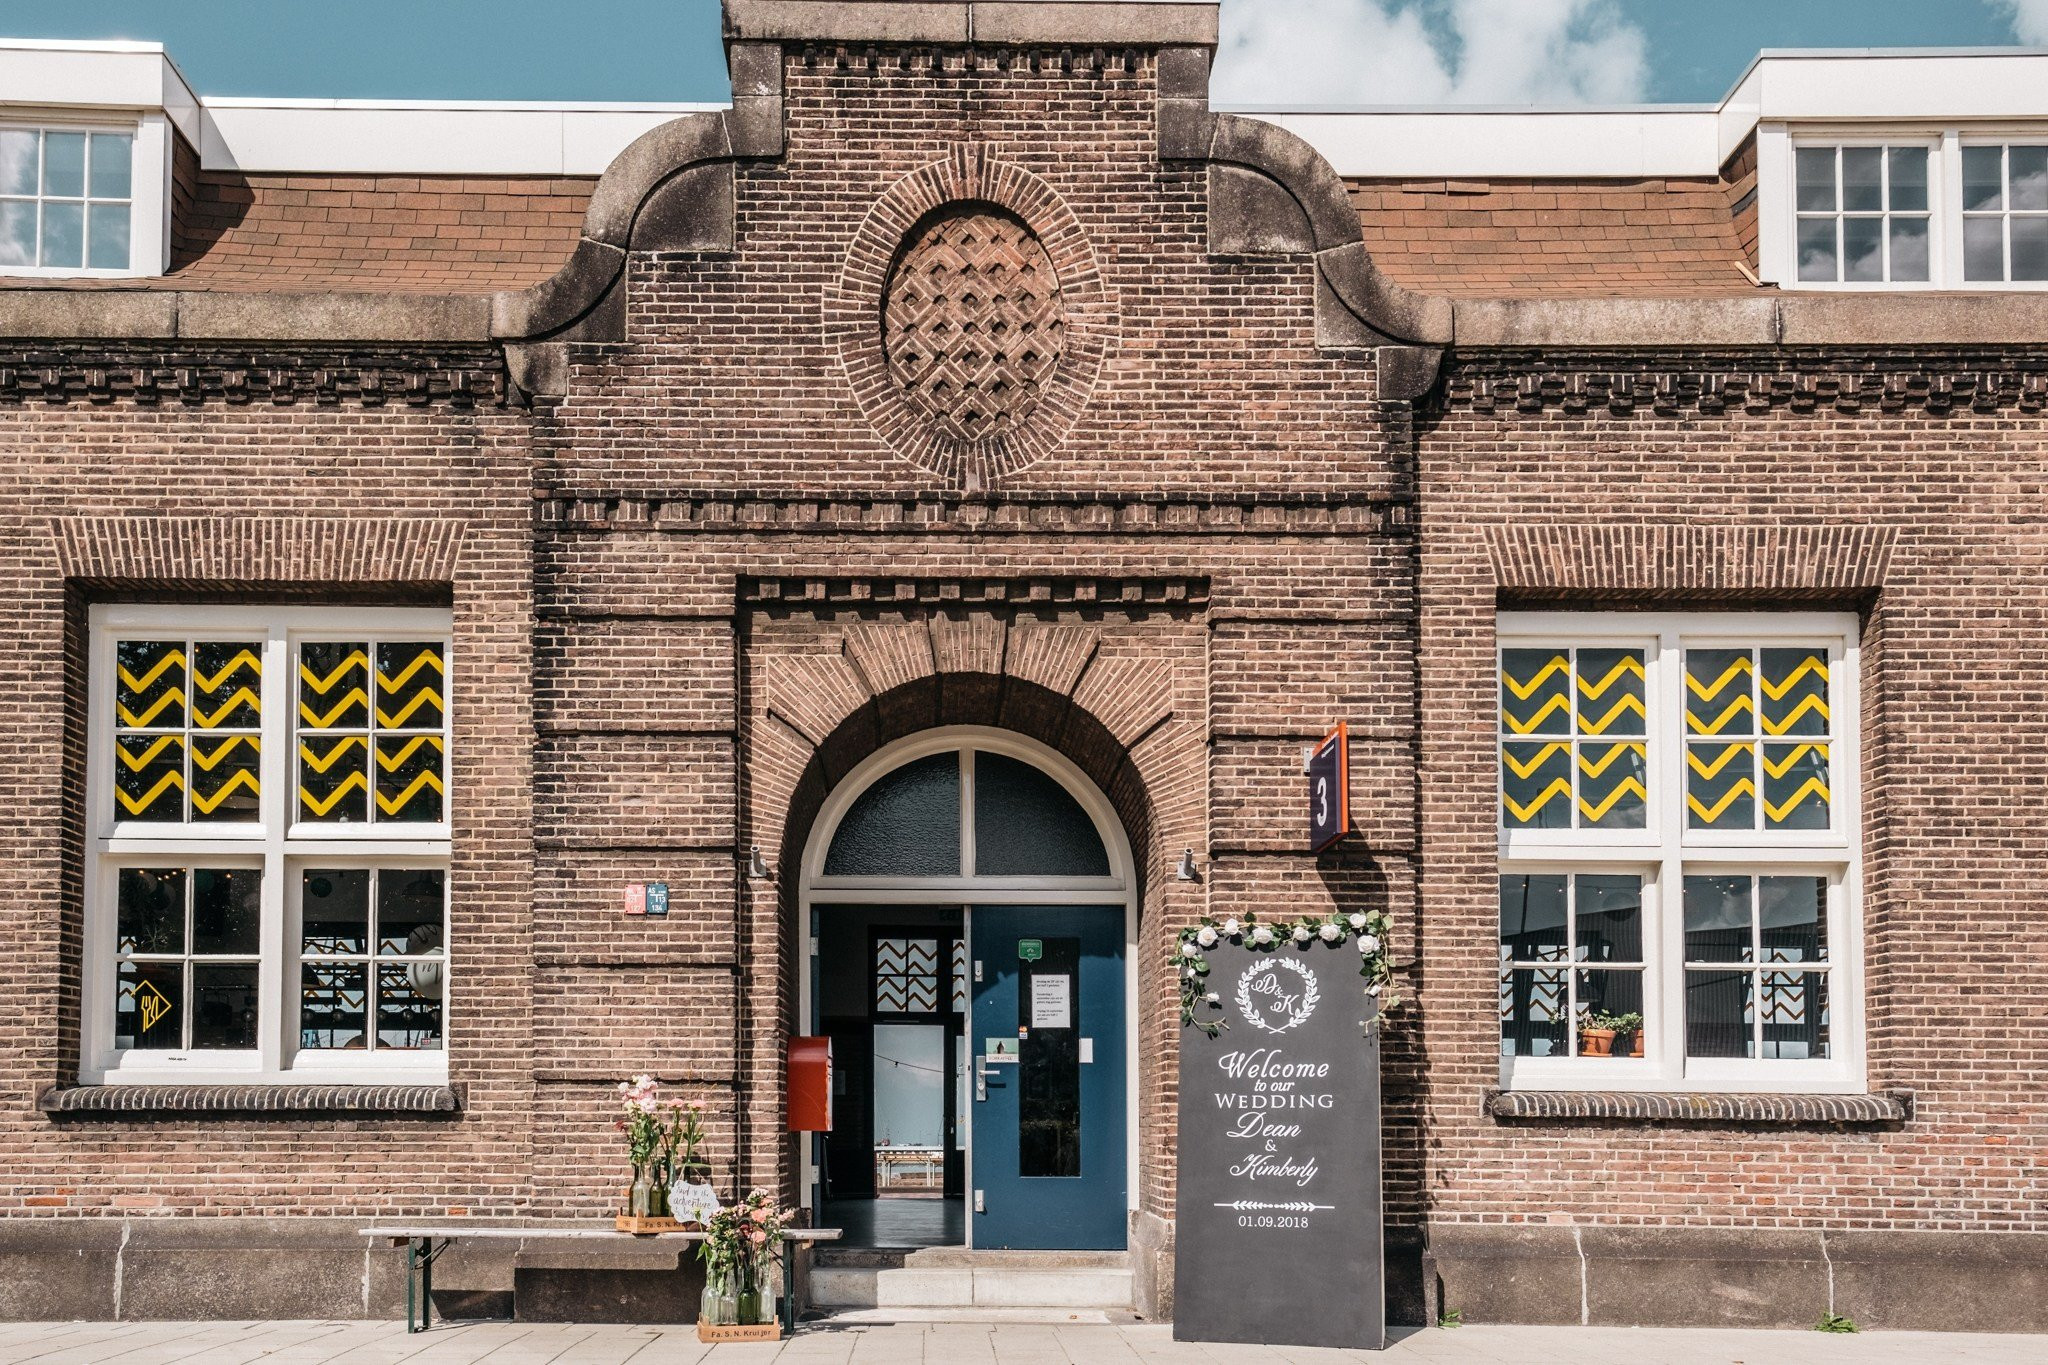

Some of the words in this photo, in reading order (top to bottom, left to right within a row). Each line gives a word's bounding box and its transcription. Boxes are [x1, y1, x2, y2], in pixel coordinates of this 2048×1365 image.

[1317, 776, 1328, 827] 3
[1218, 1048, 1330, 1078] Welcome
[1254, 1078, 1267, 1091] to
[1269, 1081, 1296, 1092] our
[1227, 1111, 1302, 1138] Dean
[1265, 1138, 1278, 1151] &
[1230, 1154, 1319, 1187] Kimberly
[1238, 1215, 1309, 1228] 01.09.2018
